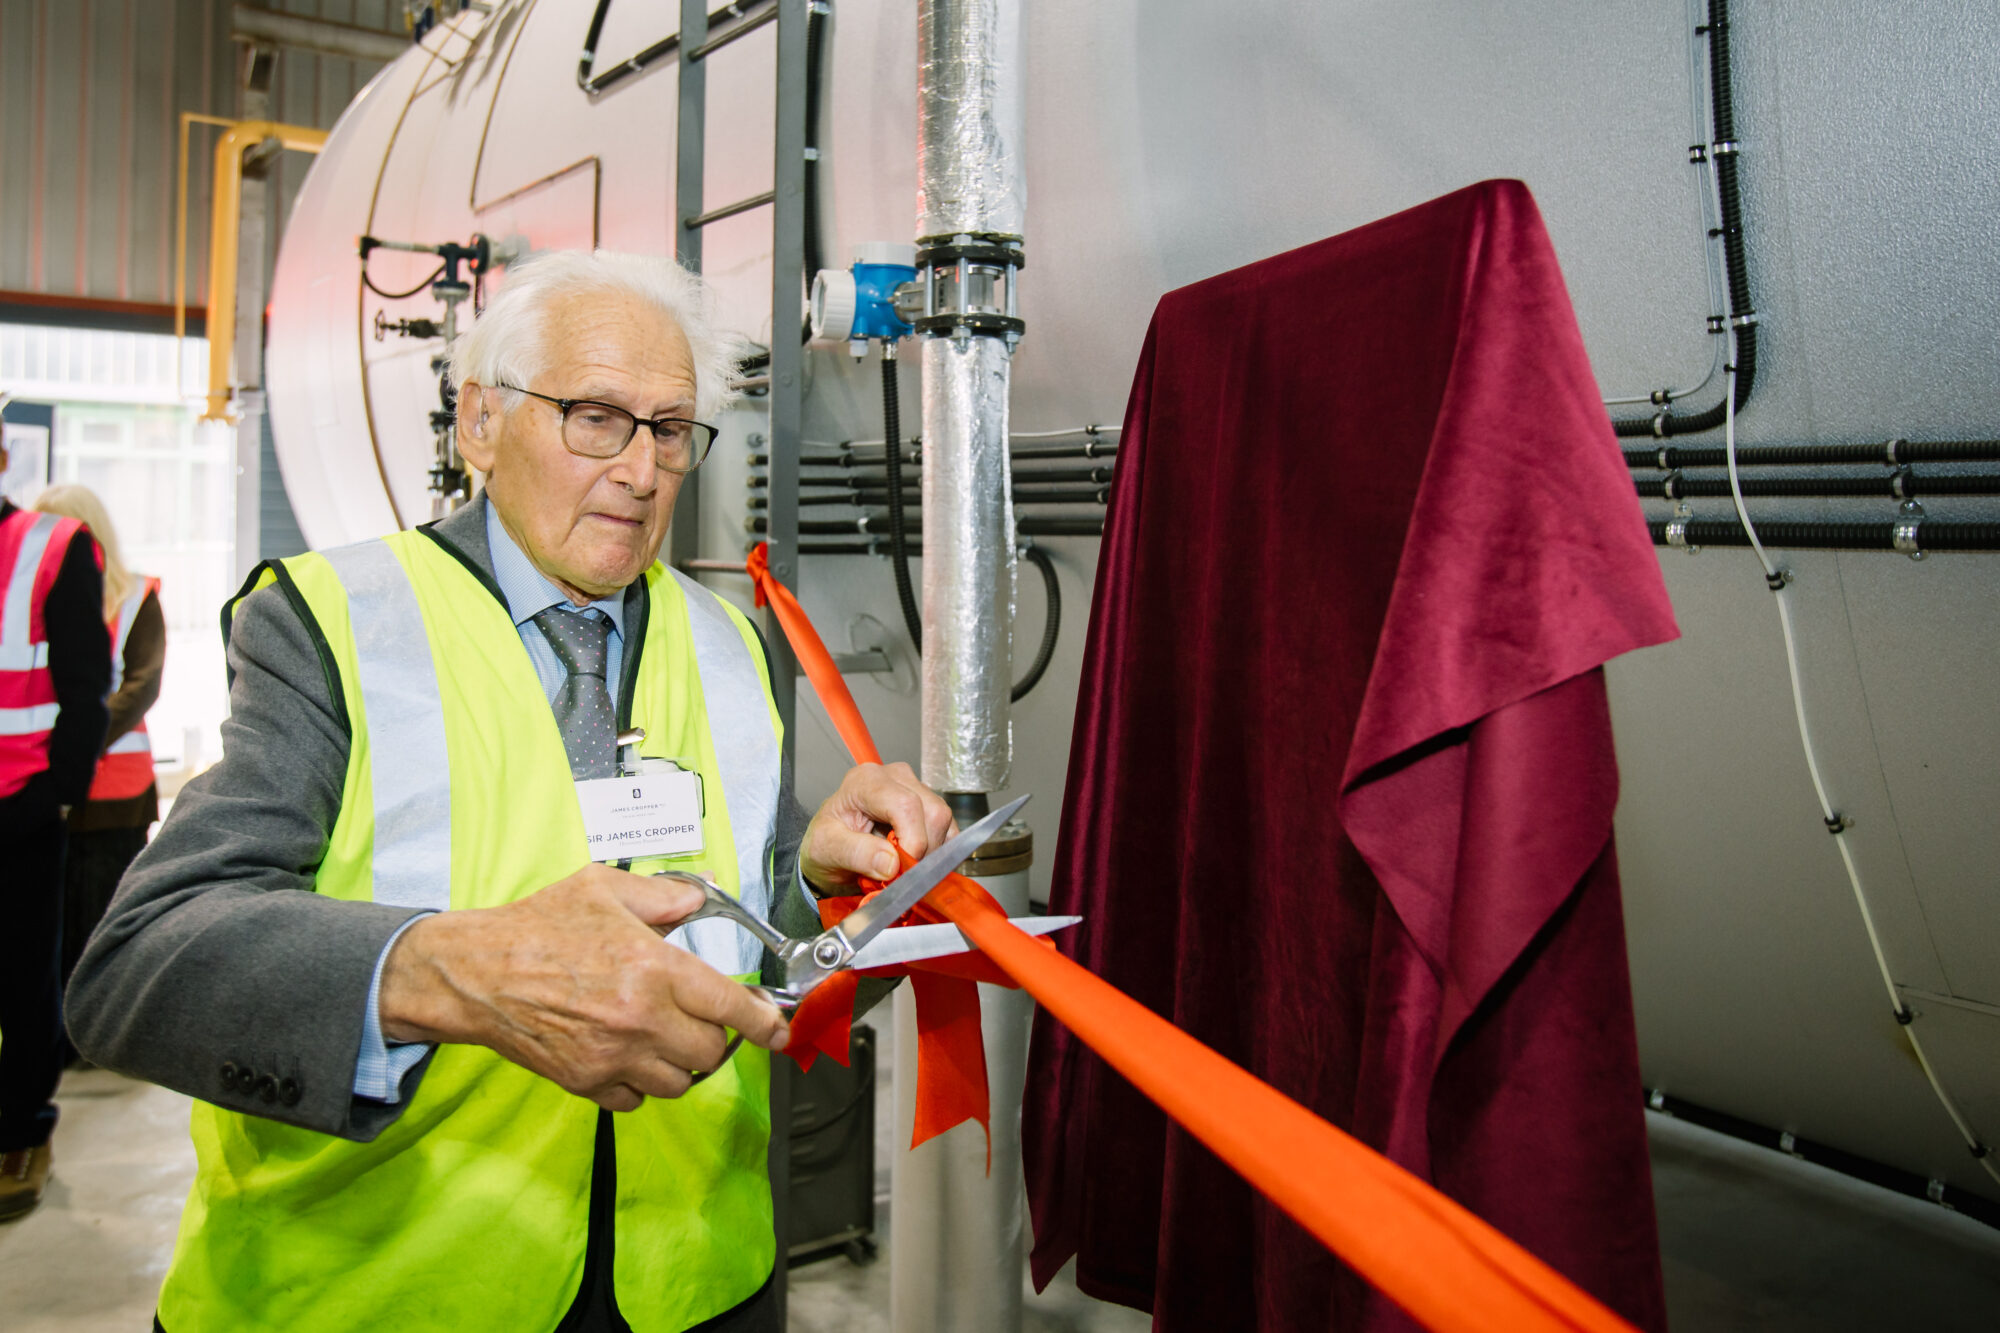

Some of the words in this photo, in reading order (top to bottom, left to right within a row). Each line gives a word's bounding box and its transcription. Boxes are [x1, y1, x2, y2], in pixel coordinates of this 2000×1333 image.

[587, 834, 603, 843] SIR
[607, 830, 641, 841] JAMES
[645, 824, 695, 837] CROPPER
